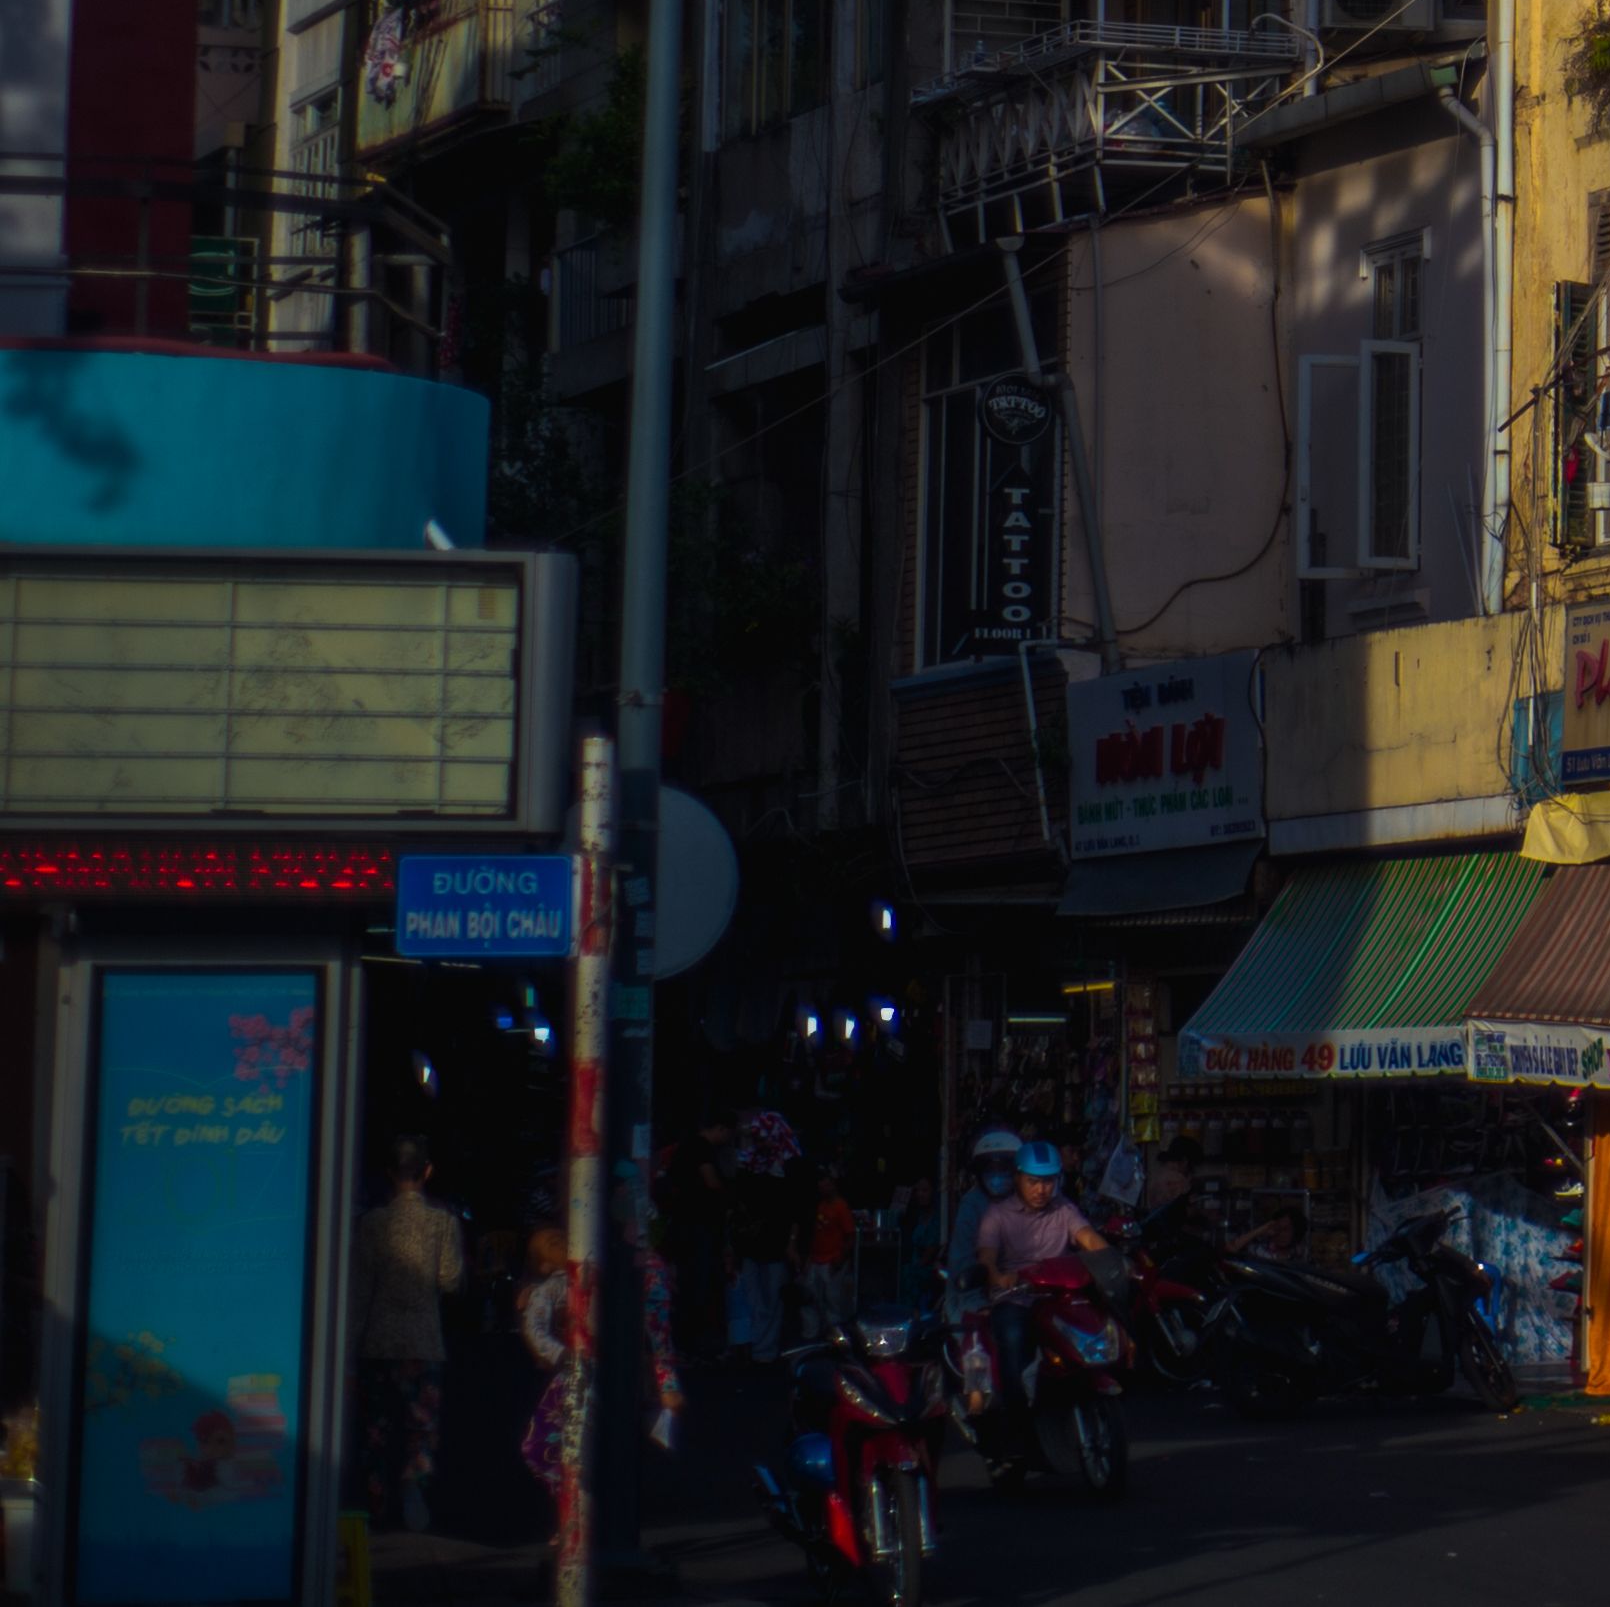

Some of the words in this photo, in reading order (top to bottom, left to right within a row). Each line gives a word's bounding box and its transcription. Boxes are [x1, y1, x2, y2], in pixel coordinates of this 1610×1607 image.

[988, 395, 1047, 419] TATTOO
[1002, 488, 1032, 622] TATTOO
[974, 627, 1024, 640] FLOOR
[432, 866, 538, 894] ĐƯỜNG
[405, 910, 460, 940] PHAN
[466, 902, 501, 949] BỘI
[506, 902, 562, 939] CHÂU
[1205, 1039, 1241, 1071] CỬA
[1246, 1041, 1296, 1071] HÀNG
[1301, 1043, 1335, 1071] 49
[1378, 1035, 1412, 1070] VĂN
[1416, 1042, 1464, 1068] LANG
[1581, 1036, 1604, 1080] SHOP
